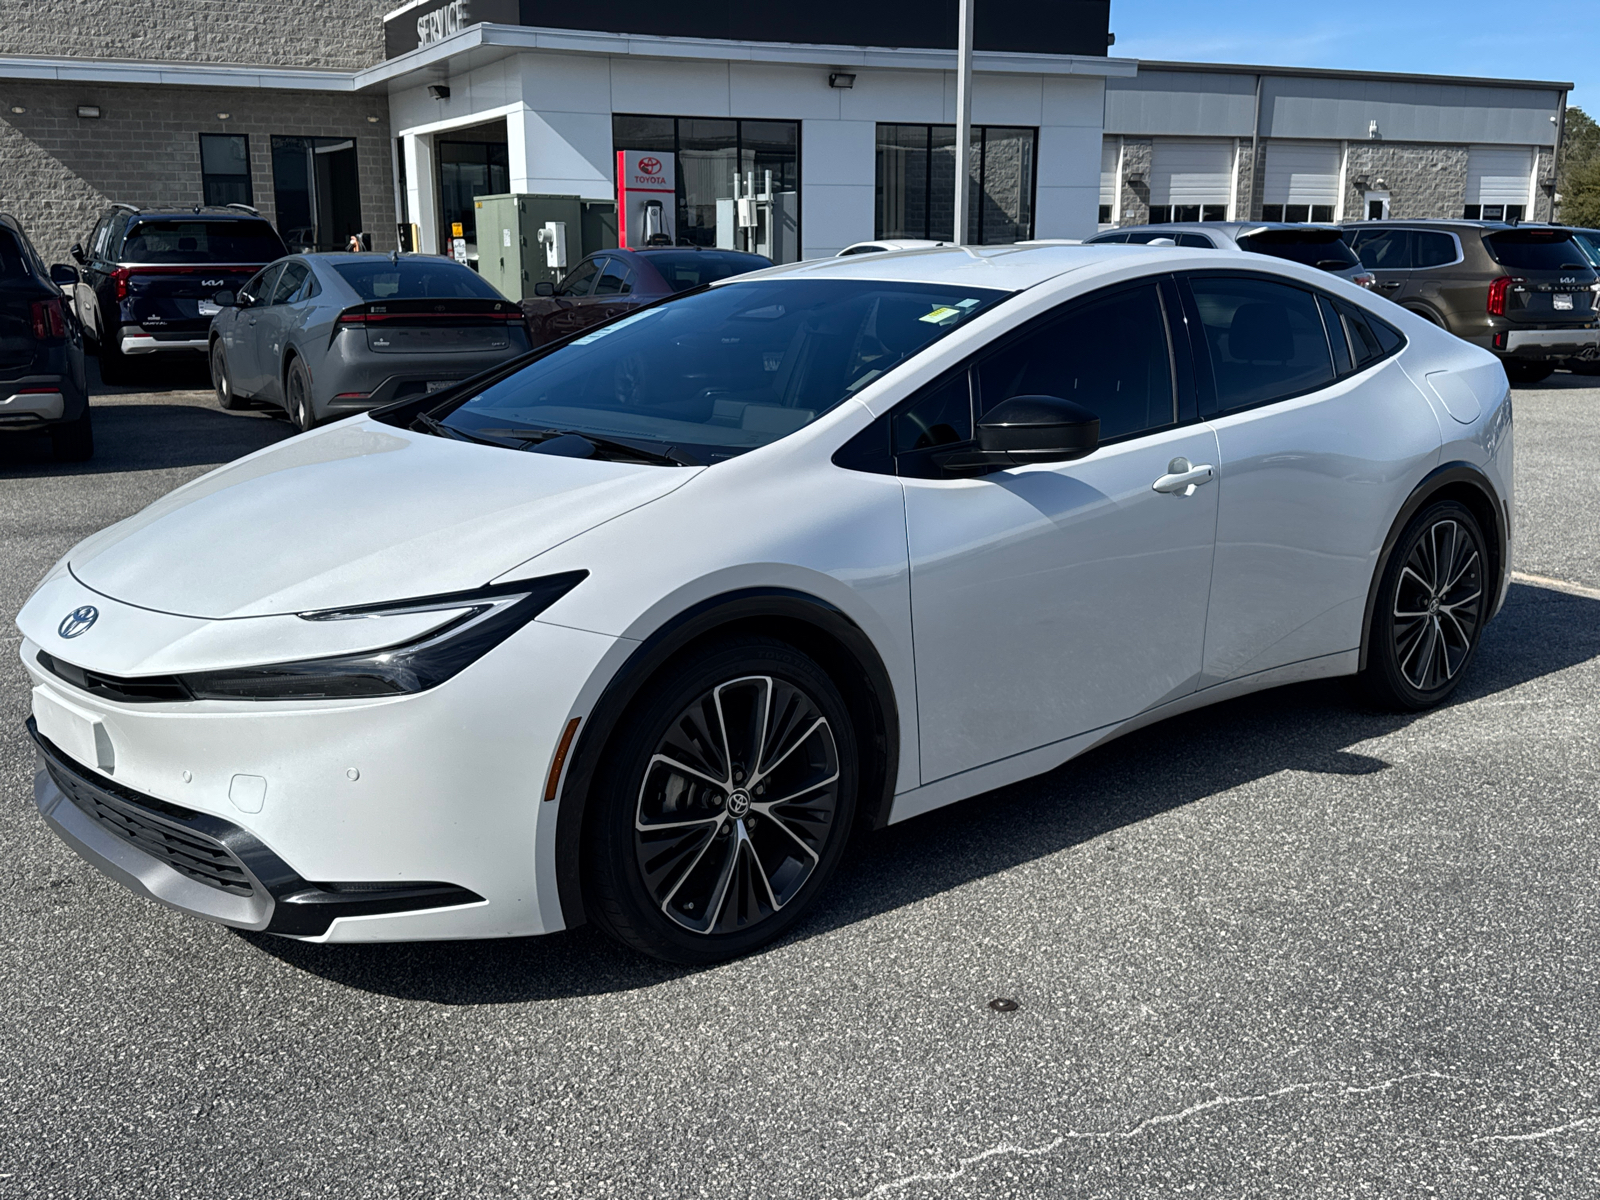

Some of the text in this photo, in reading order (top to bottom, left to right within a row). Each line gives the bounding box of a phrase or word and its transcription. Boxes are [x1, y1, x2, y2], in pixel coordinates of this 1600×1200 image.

[416, 0, 466, 47] SERVICE
[634, 176, 666, 184] TOYOTA
[757, 651, 791, 662] TOYO
